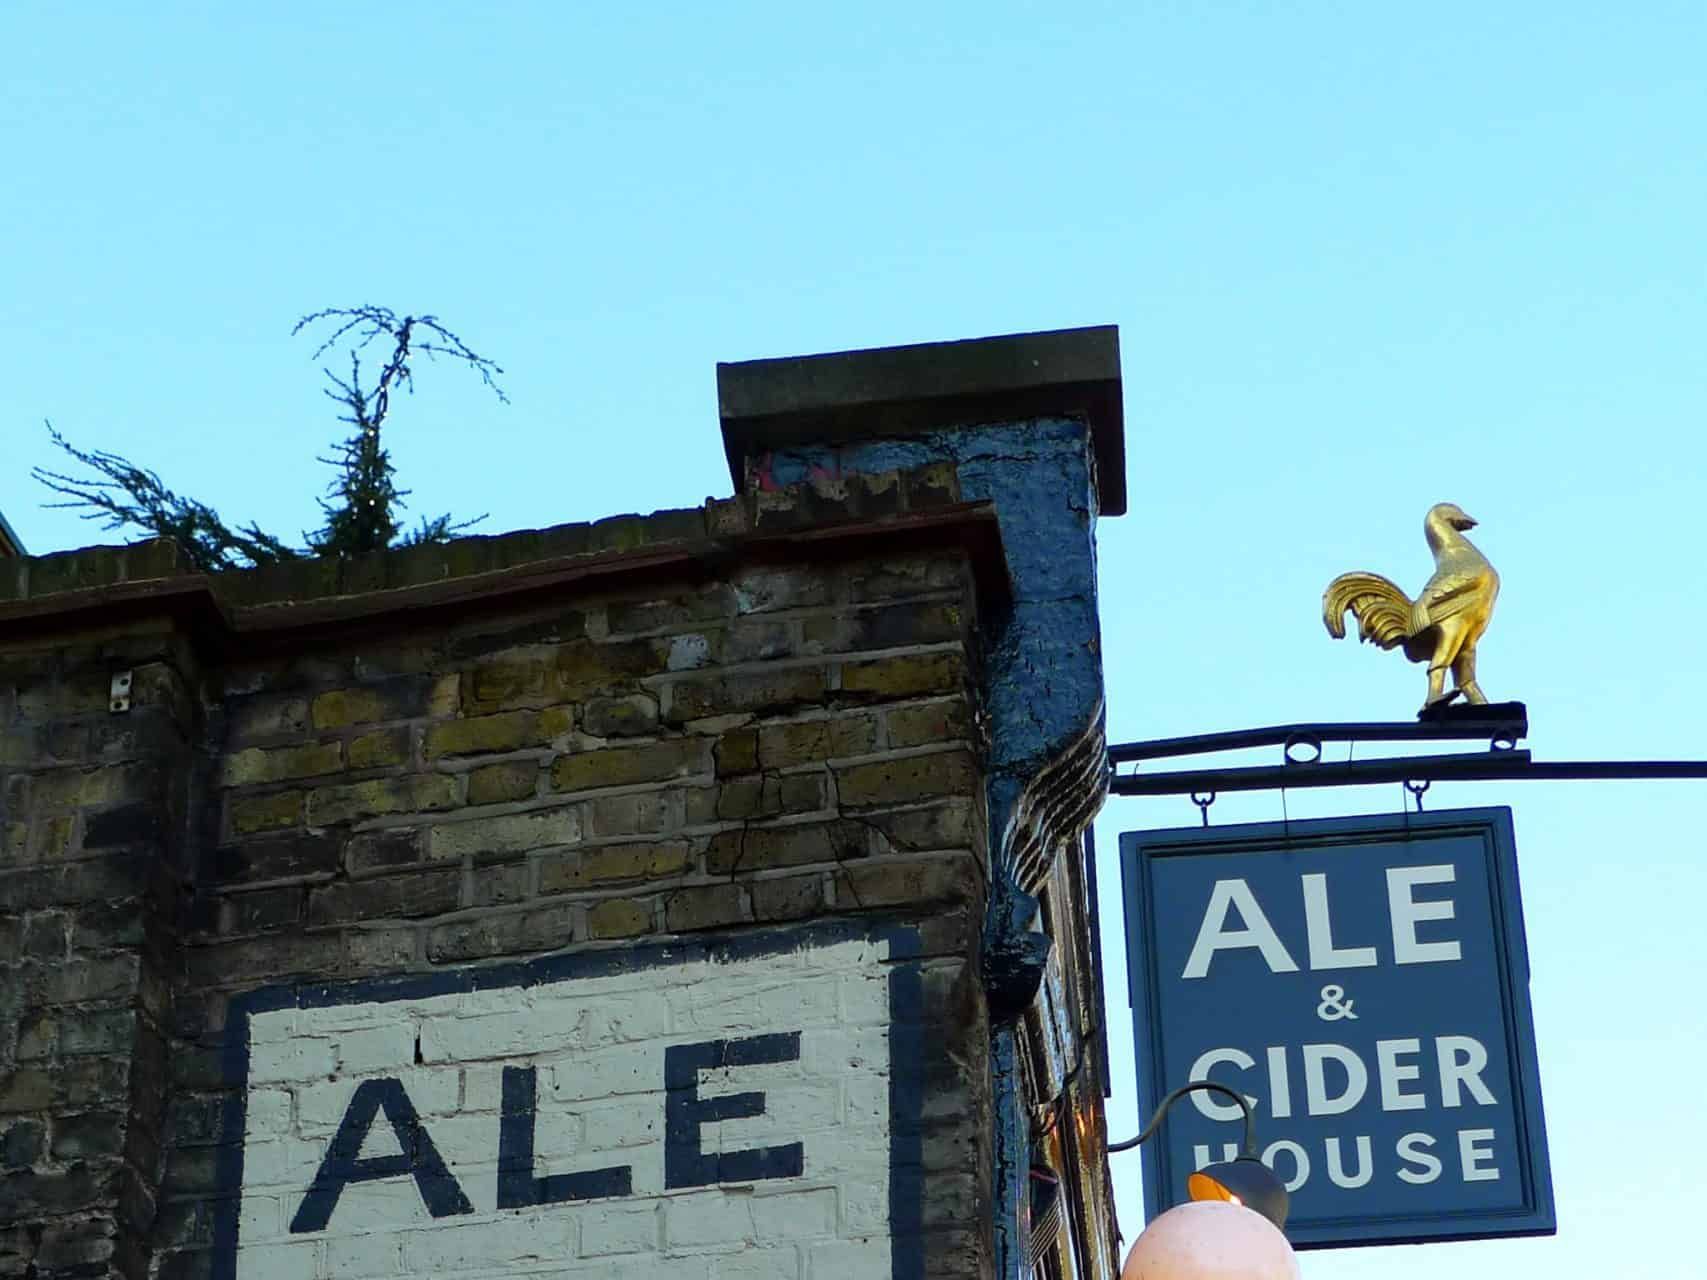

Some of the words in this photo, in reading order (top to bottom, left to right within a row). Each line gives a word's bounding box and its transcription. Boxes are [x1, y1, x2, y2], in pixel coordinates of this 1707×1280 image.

[1181, 863, 1462, 979] ALE
[1316, 984, 1359, 1021] &
[1188, 1036, 1499, 1122] CIDER
[289, 1030, 803, 1234] ALE
